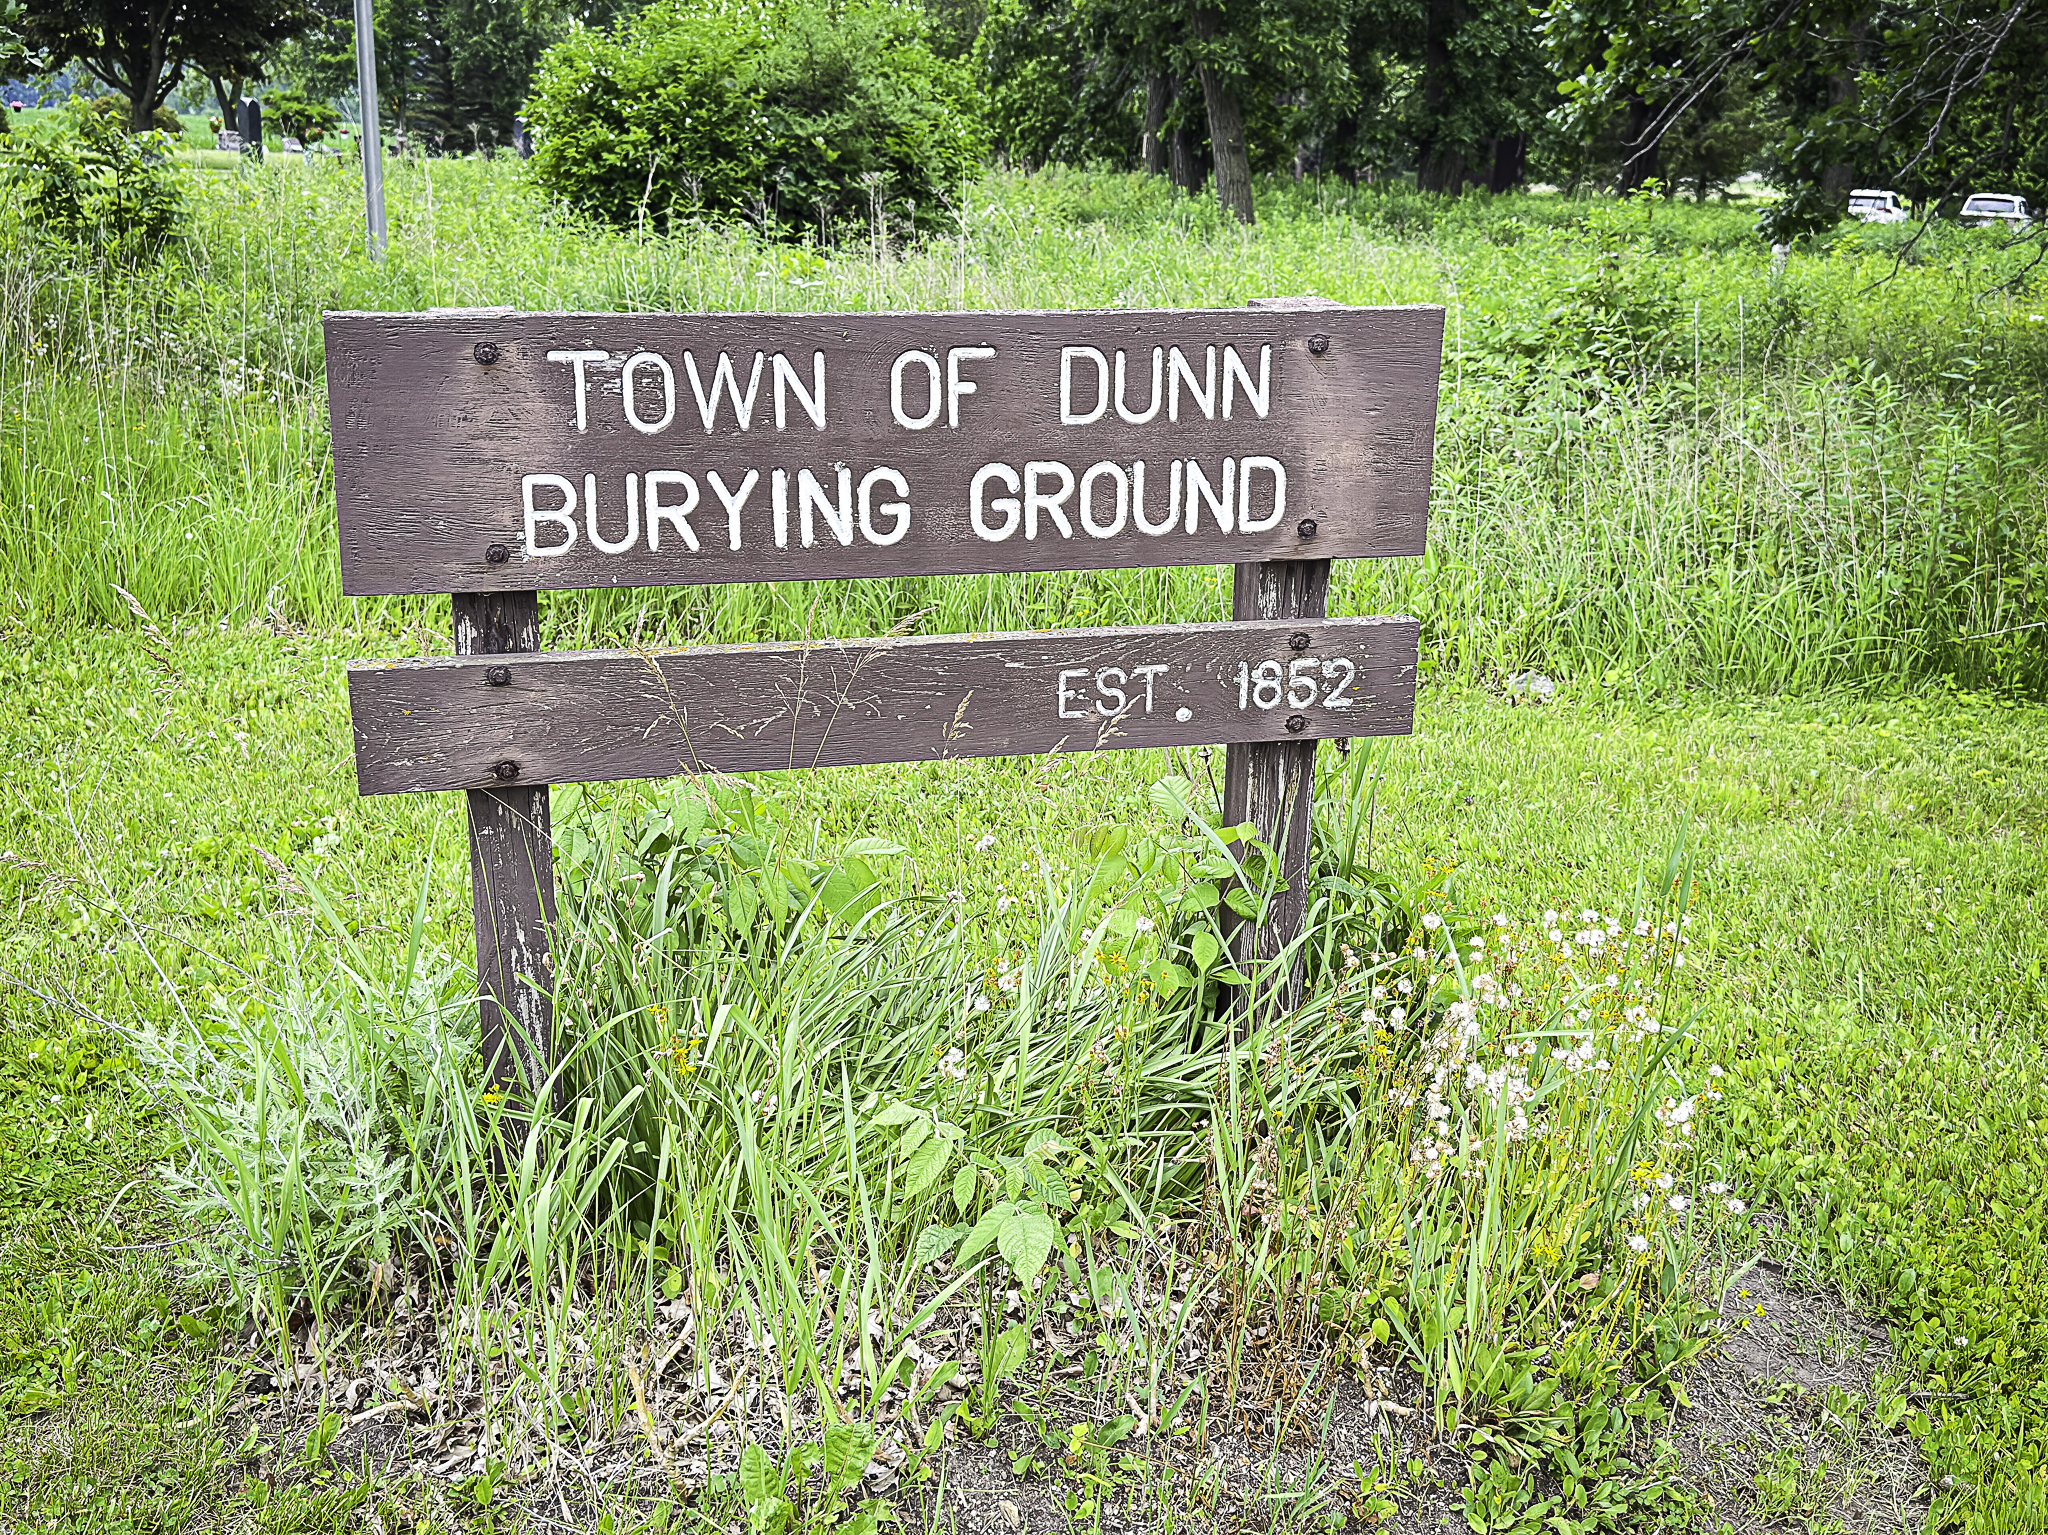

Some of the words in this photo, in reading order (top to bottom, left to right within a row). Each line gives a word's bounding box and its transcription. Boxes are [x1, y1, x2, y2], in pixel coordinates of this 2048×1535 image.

[547, 350, 827, 433] TOWN
[890, 346, 997, 430] OF
[1060, 344, 1272, 425] DUNN
[521, 466, 911, 557] BURYING
[969, 456, 1287, 541] GROUND
[1057, 664, 1193, 723] EST.
[1236, 657, 1356, 711] 1852
